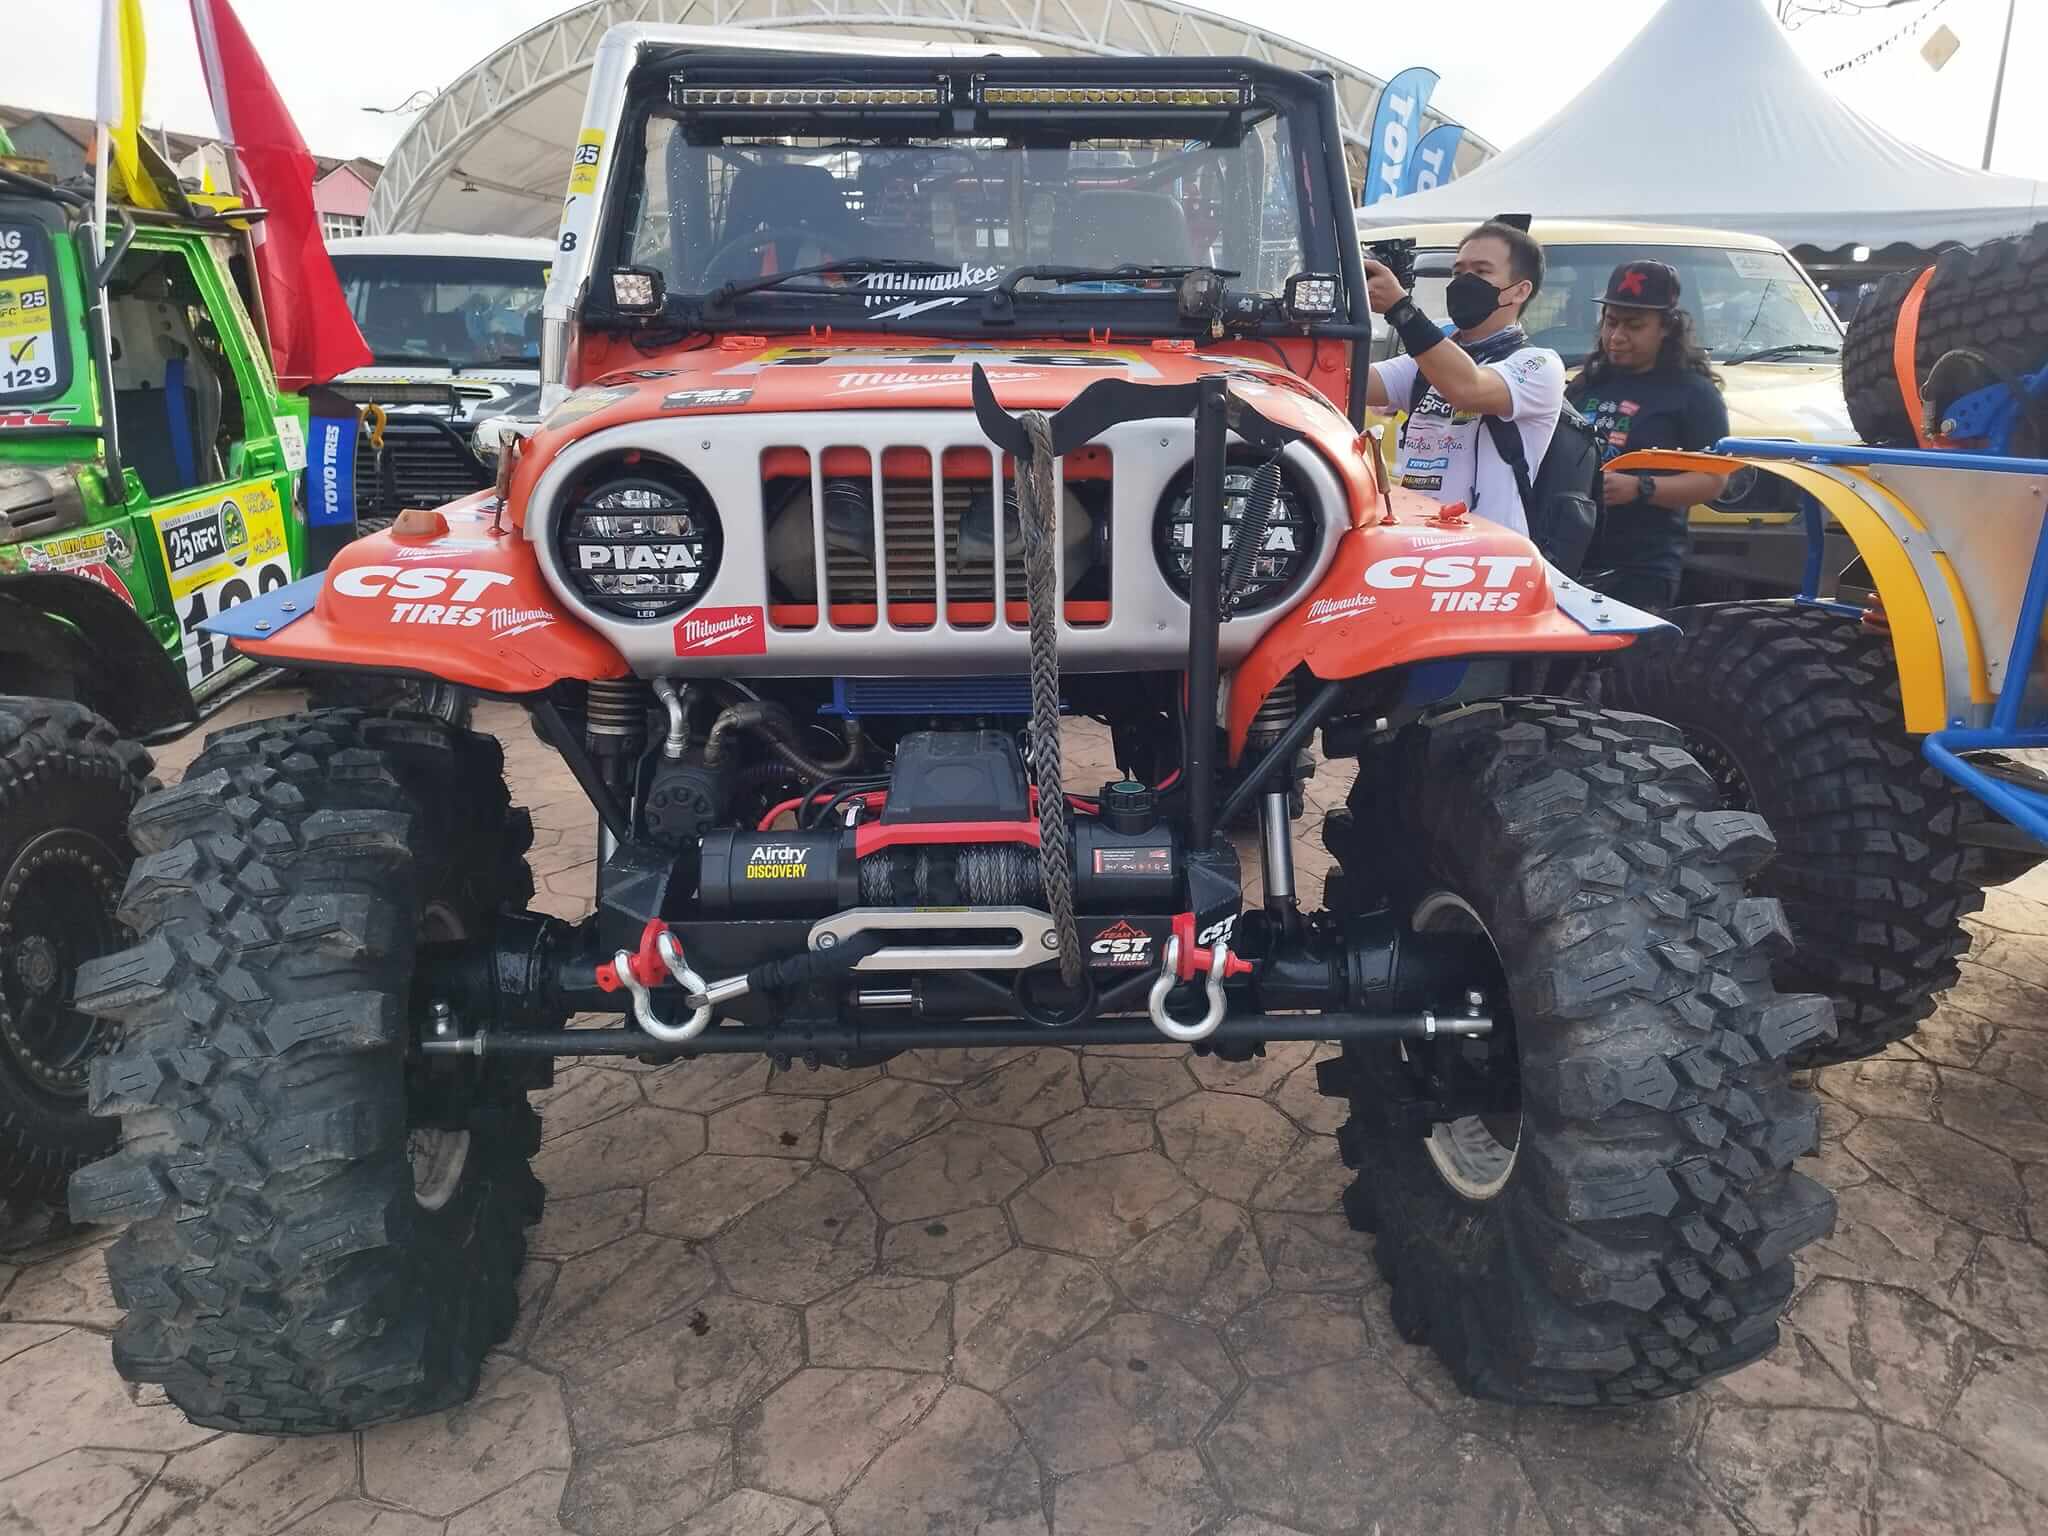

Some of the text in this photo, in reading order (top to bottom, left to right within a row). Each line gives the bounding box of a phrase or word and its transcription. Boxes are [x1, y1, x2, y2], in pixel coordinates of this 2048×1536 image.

[576, 144, 600, 164] 25
[560, 231, 577, 252] 8
[856, 262, 1000, 308] Milwaukee
[22, 291, 46, 306] 25
[3, 365, 51, 388] 129
[324, 424, 339, 514] TOYO TIRES
[578, 544, 698, 570] PIAA
[333, 565, 515, 602] CST
[1364, 556, 1534, 589] CST
[1307, 592, 1377, 619] Milwaukee
[1430, 591, 1521, 612] TIRES
[391, 603, 484, 626] TIRES
[682, 613, 754, 643] Milwaukee
[751, 846, 811, 863] Airdry
[747, 864, 807, 878] DISCOVERY
[1198, 914, 1237, 945] CST
[1090, 937, 1152, 953] CST
[1113, 952, 1145, 962] TIRES
